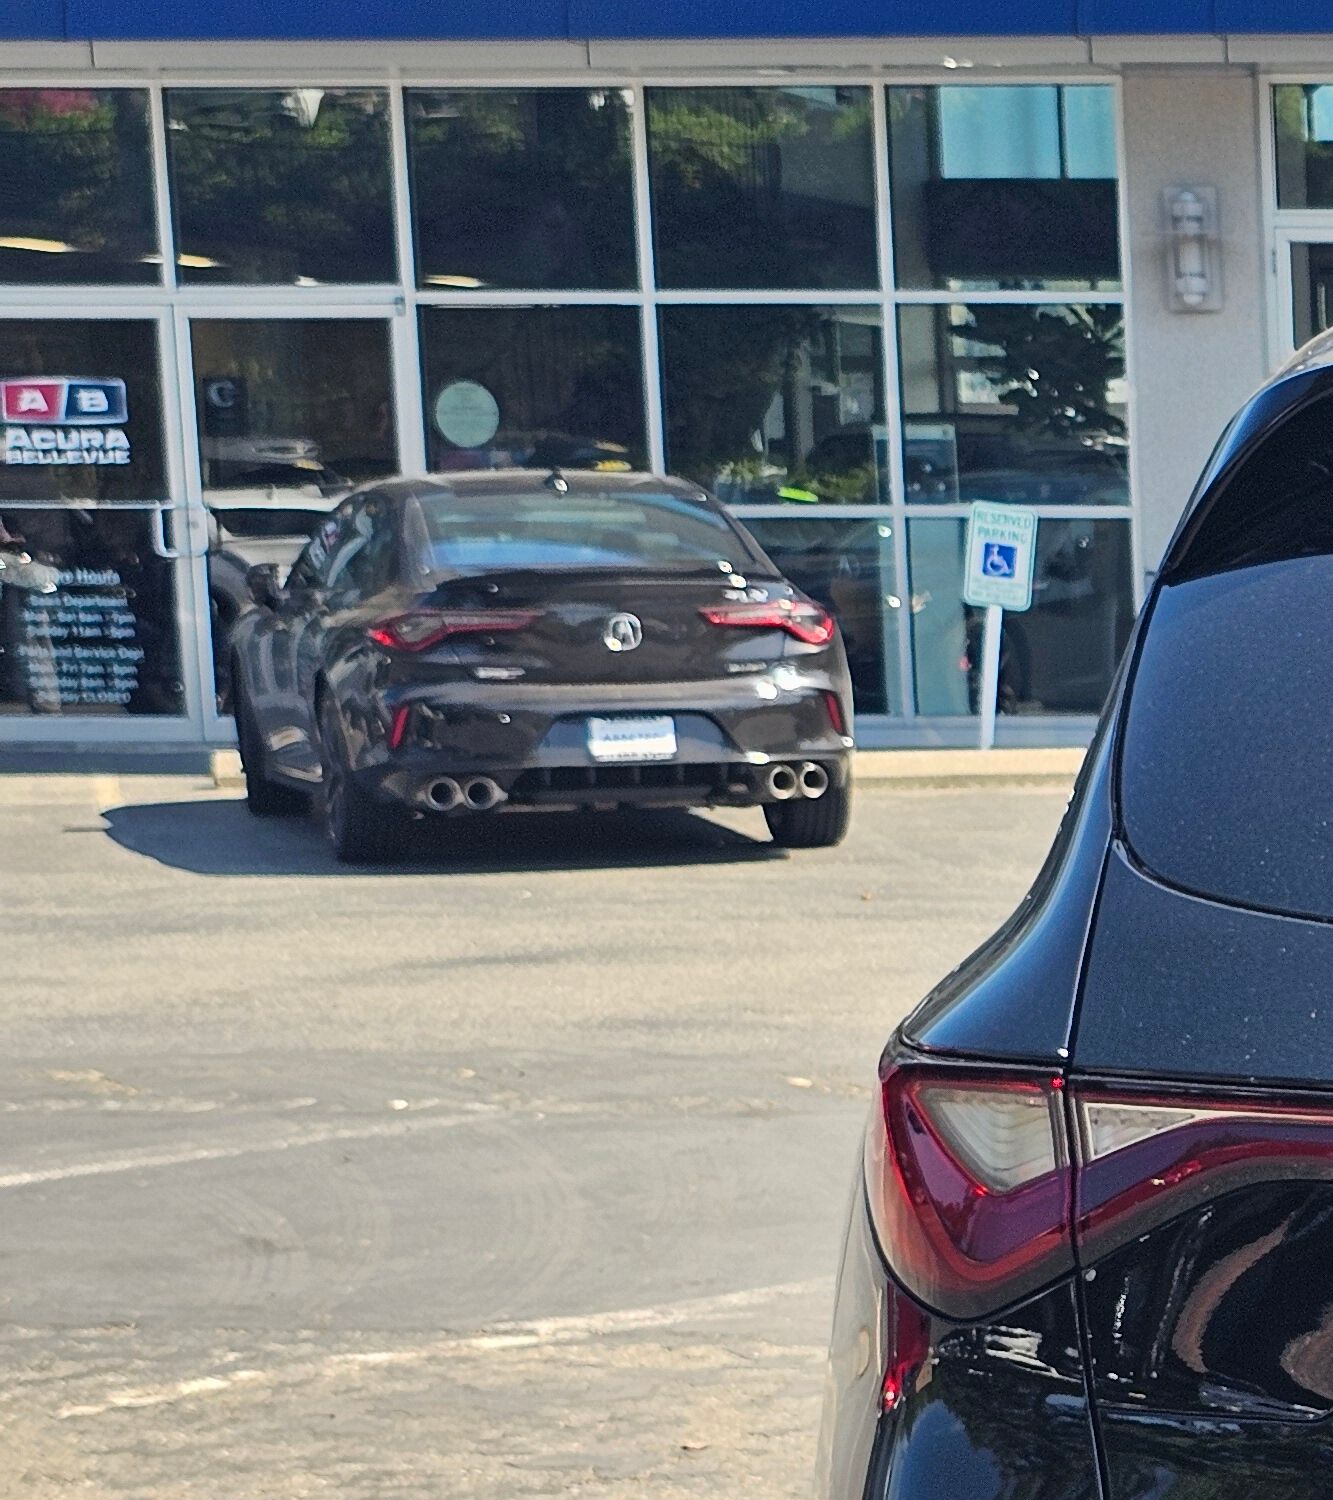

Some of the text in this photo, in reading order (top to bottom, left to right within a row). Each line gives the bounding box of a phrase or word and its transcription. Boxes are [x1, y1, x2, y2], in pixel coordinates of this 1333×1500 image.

[18, 388, 109, 412] A B
[5, 427, 131, 450] ACURA
[5, 450, 131, 465] BELLEVUE
[976, 510, 1032, 530] RESERVED
[977, 526, 1027, 545] PARKING
